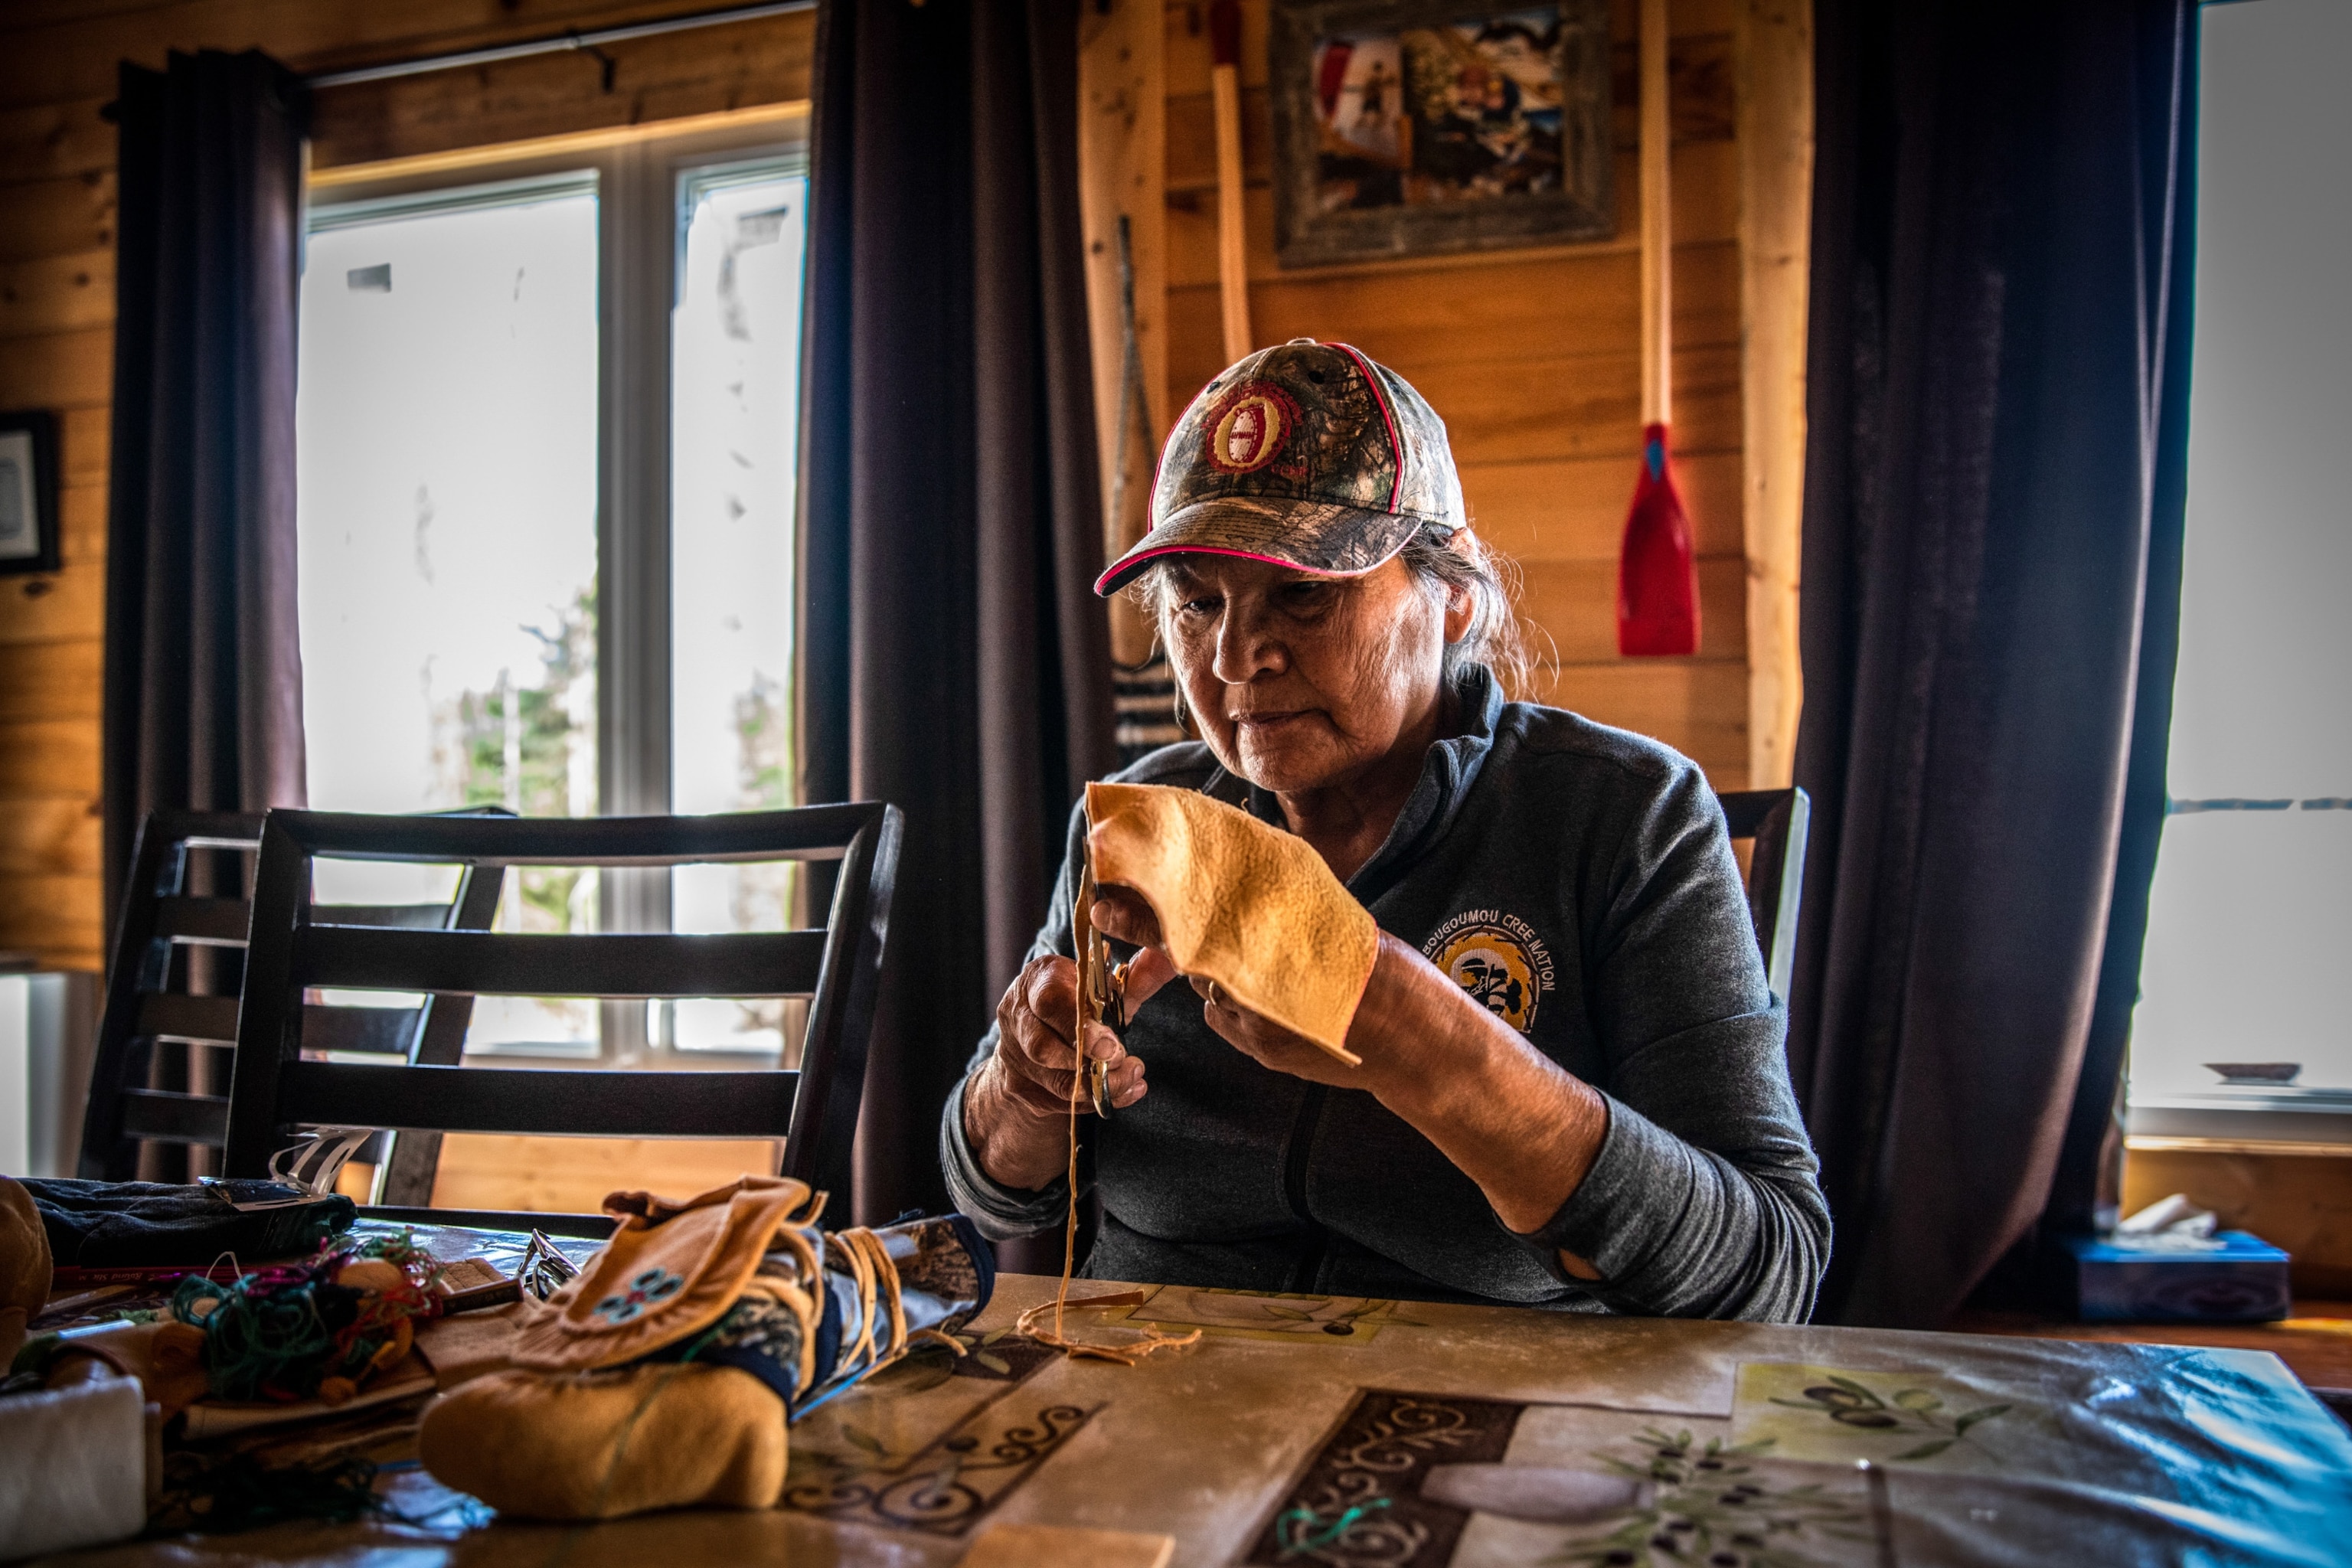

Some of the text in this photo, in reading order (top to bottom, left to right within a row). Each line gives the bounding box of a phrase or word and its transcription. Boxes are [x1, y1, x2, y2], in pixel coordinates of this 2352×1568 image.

[1422, 909, 1556, 991] BOUGOUMOU CREE NATION
